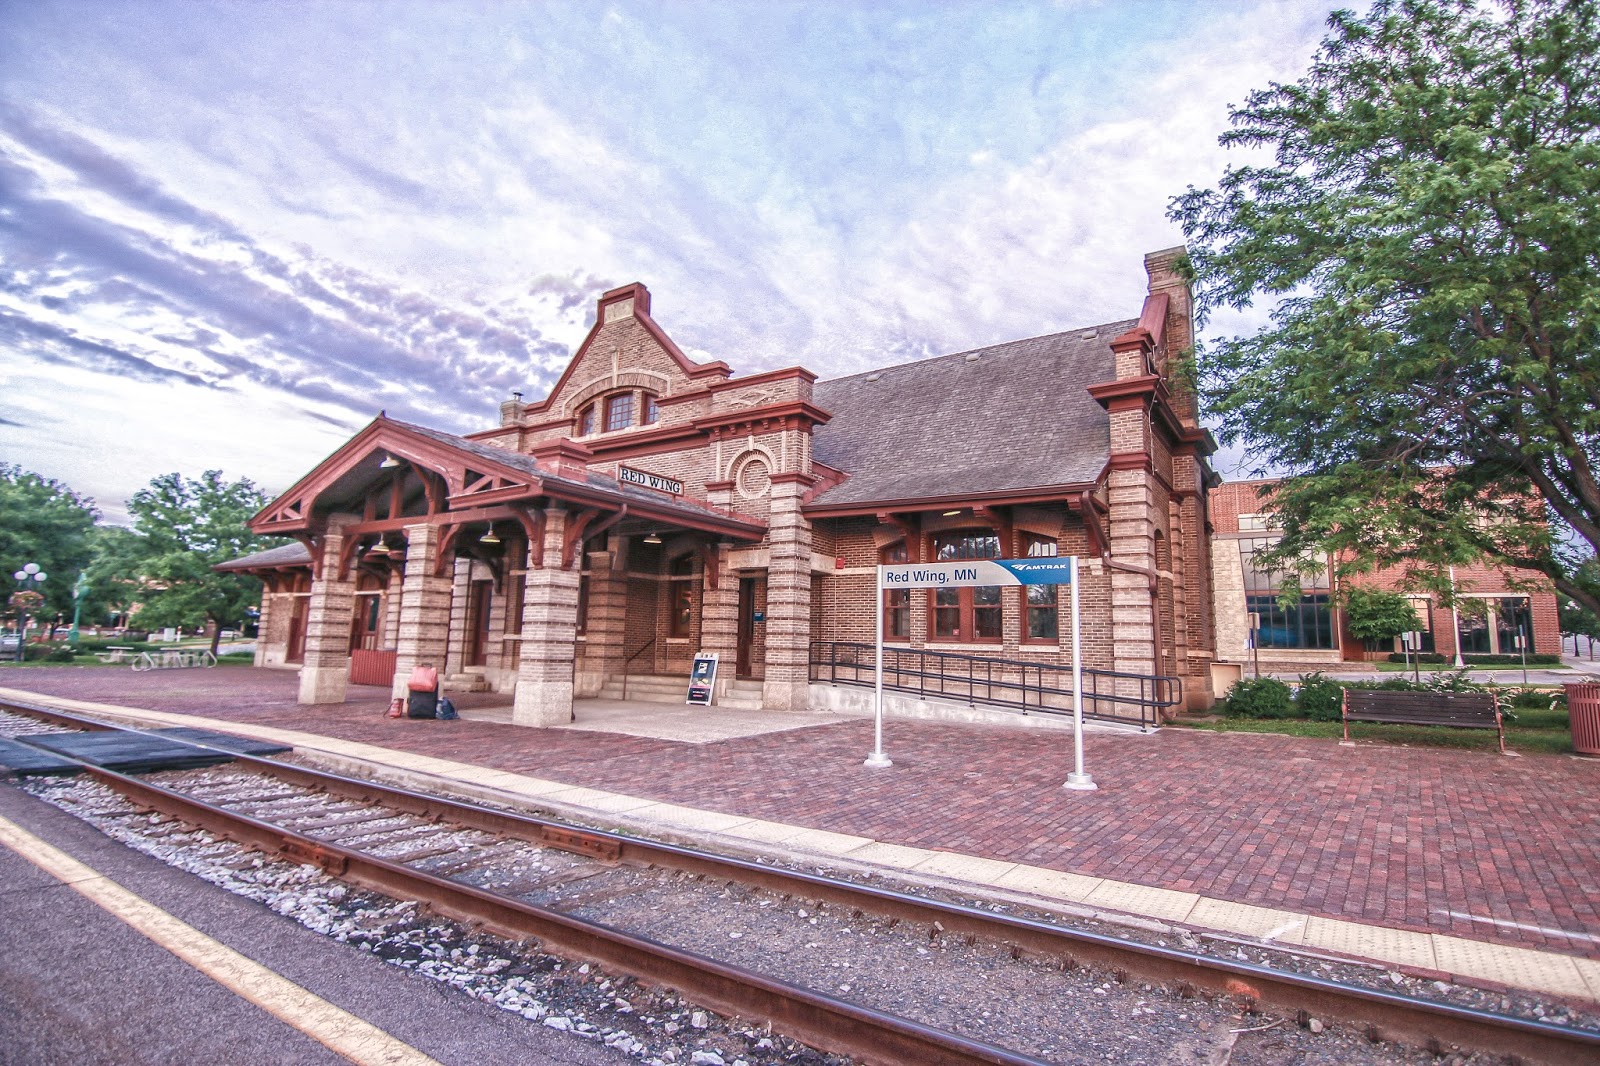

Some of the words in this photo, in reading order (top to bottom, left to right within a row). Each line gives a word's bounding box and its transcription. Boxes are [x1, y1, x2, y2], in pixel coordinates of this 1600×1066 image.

[621, 469, 645, 483] RED
[649, 476, 680, 493] WING
[886, 570, 909, 582] Red
[913, 570, 949, 583] Wing,
[954, 568, 977, 580] MN
